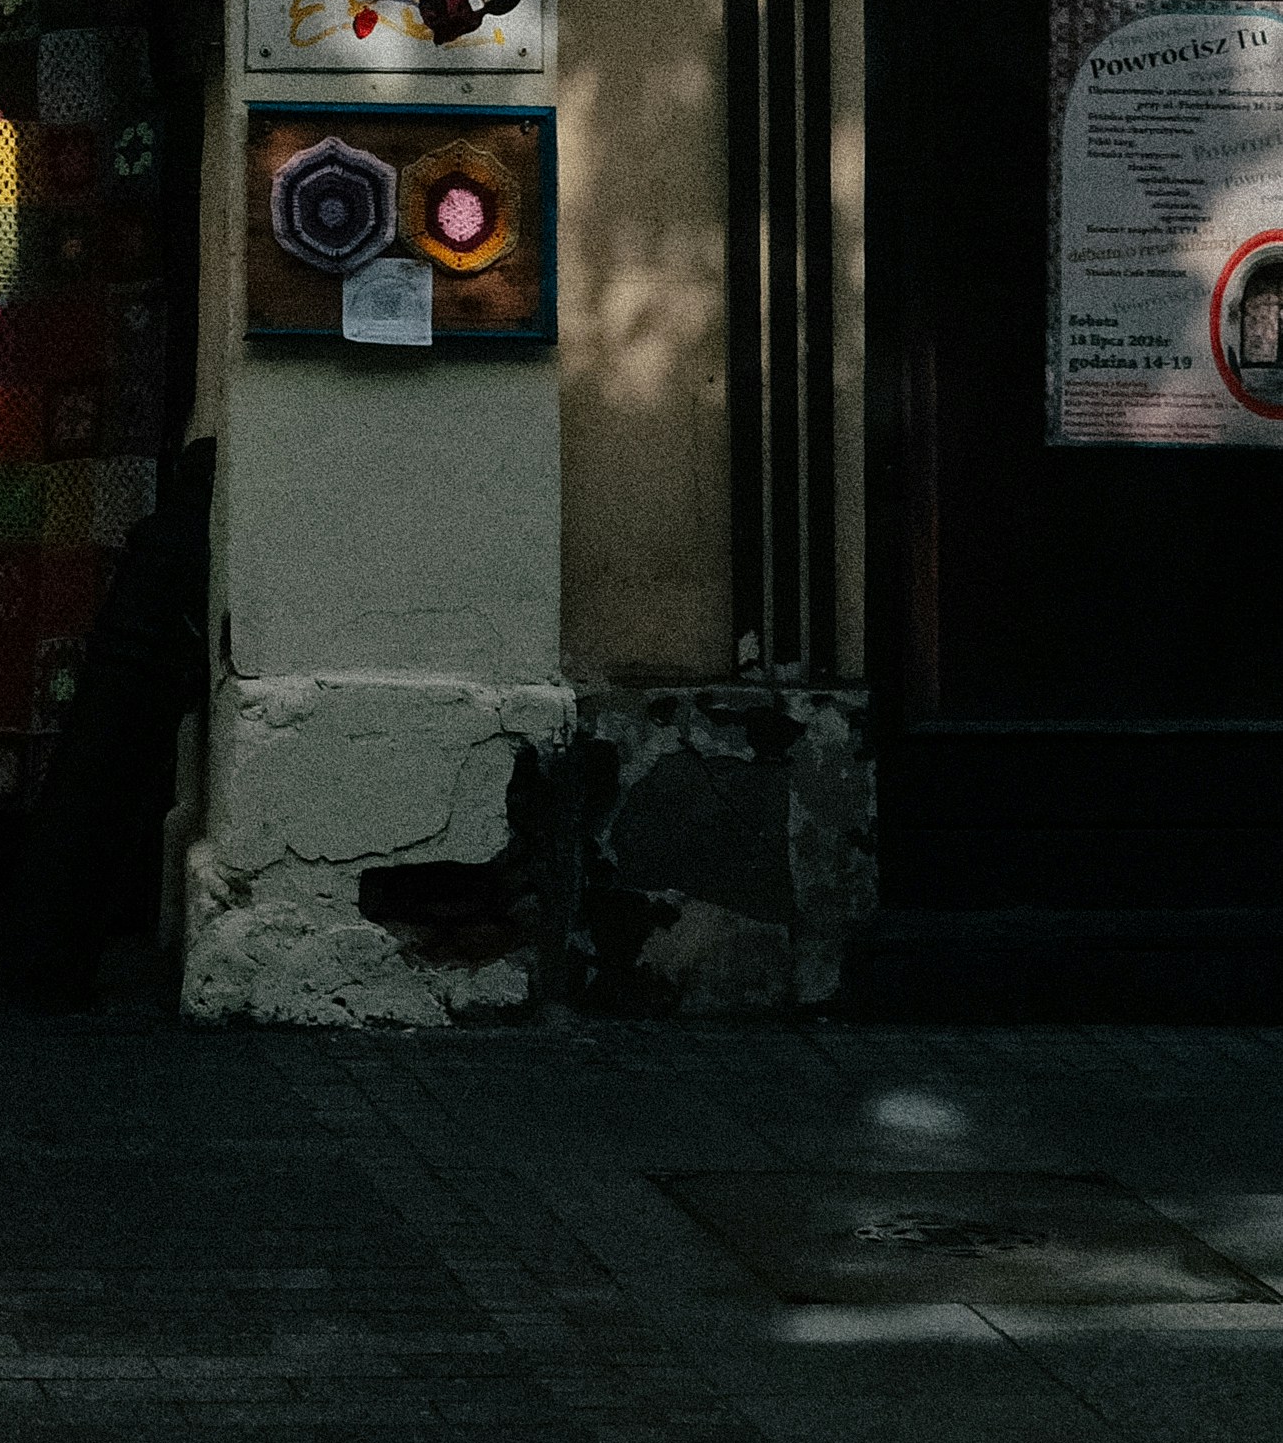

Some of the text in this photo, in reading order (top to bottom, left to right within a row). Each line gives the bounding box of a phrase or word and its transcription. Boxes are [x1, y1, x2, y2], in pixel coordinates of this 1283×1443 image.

[1233, 27, 1269, 50] Tu
[1068, 313, 1119, 328] Sobota
[1068, 353, 1139, 373] godzina
